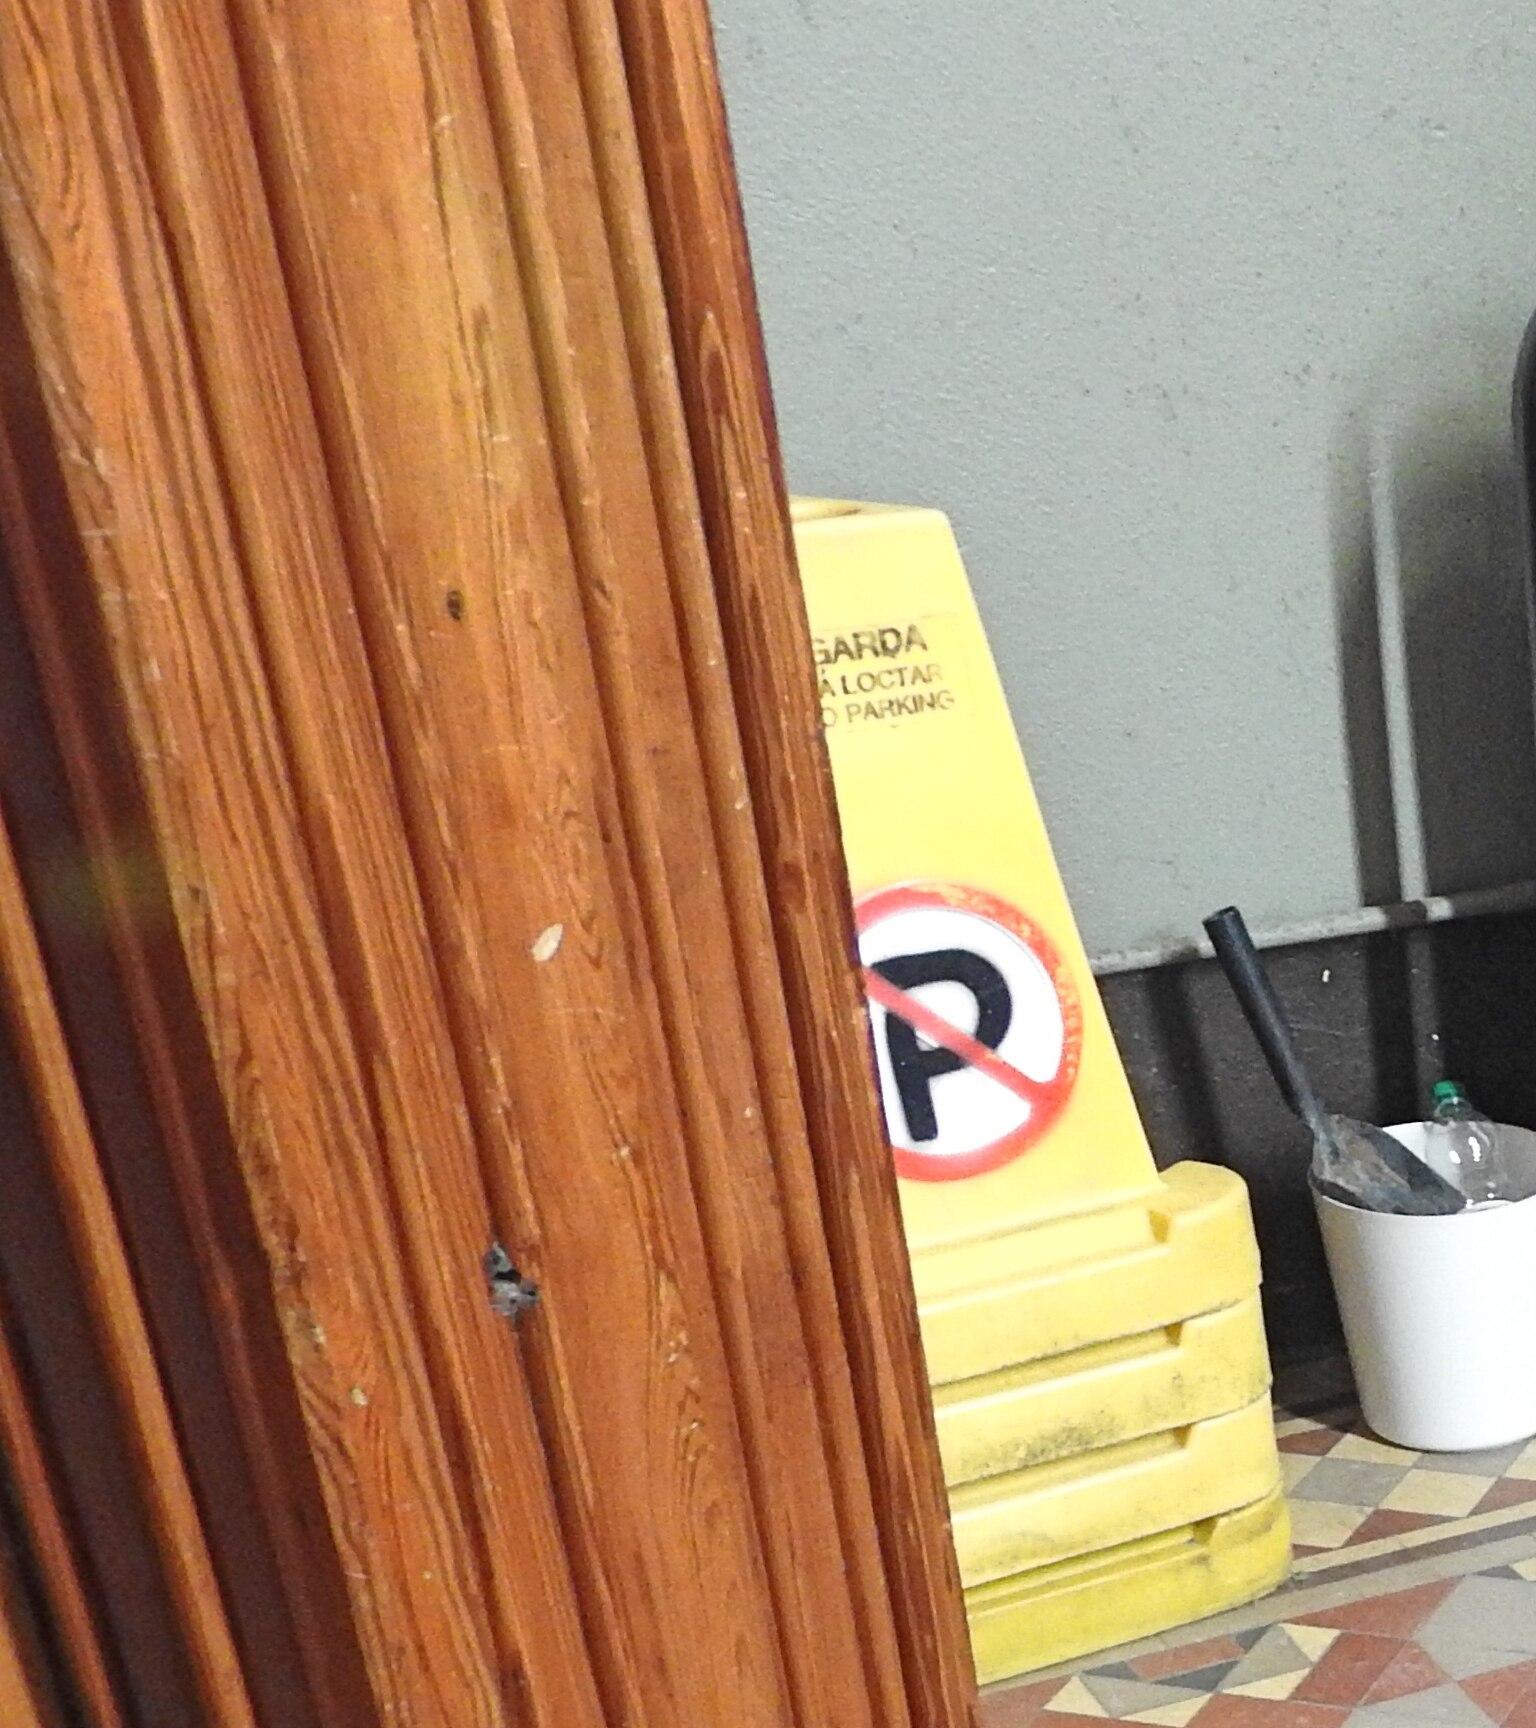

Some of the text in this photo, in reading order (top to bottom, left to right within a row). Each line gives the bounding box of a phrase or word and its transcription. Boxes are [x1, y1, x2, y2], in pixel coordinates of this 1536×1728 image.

[841, 664, 943, 695] LOCTAR
[822, 690, 955, 727] O PARKING
